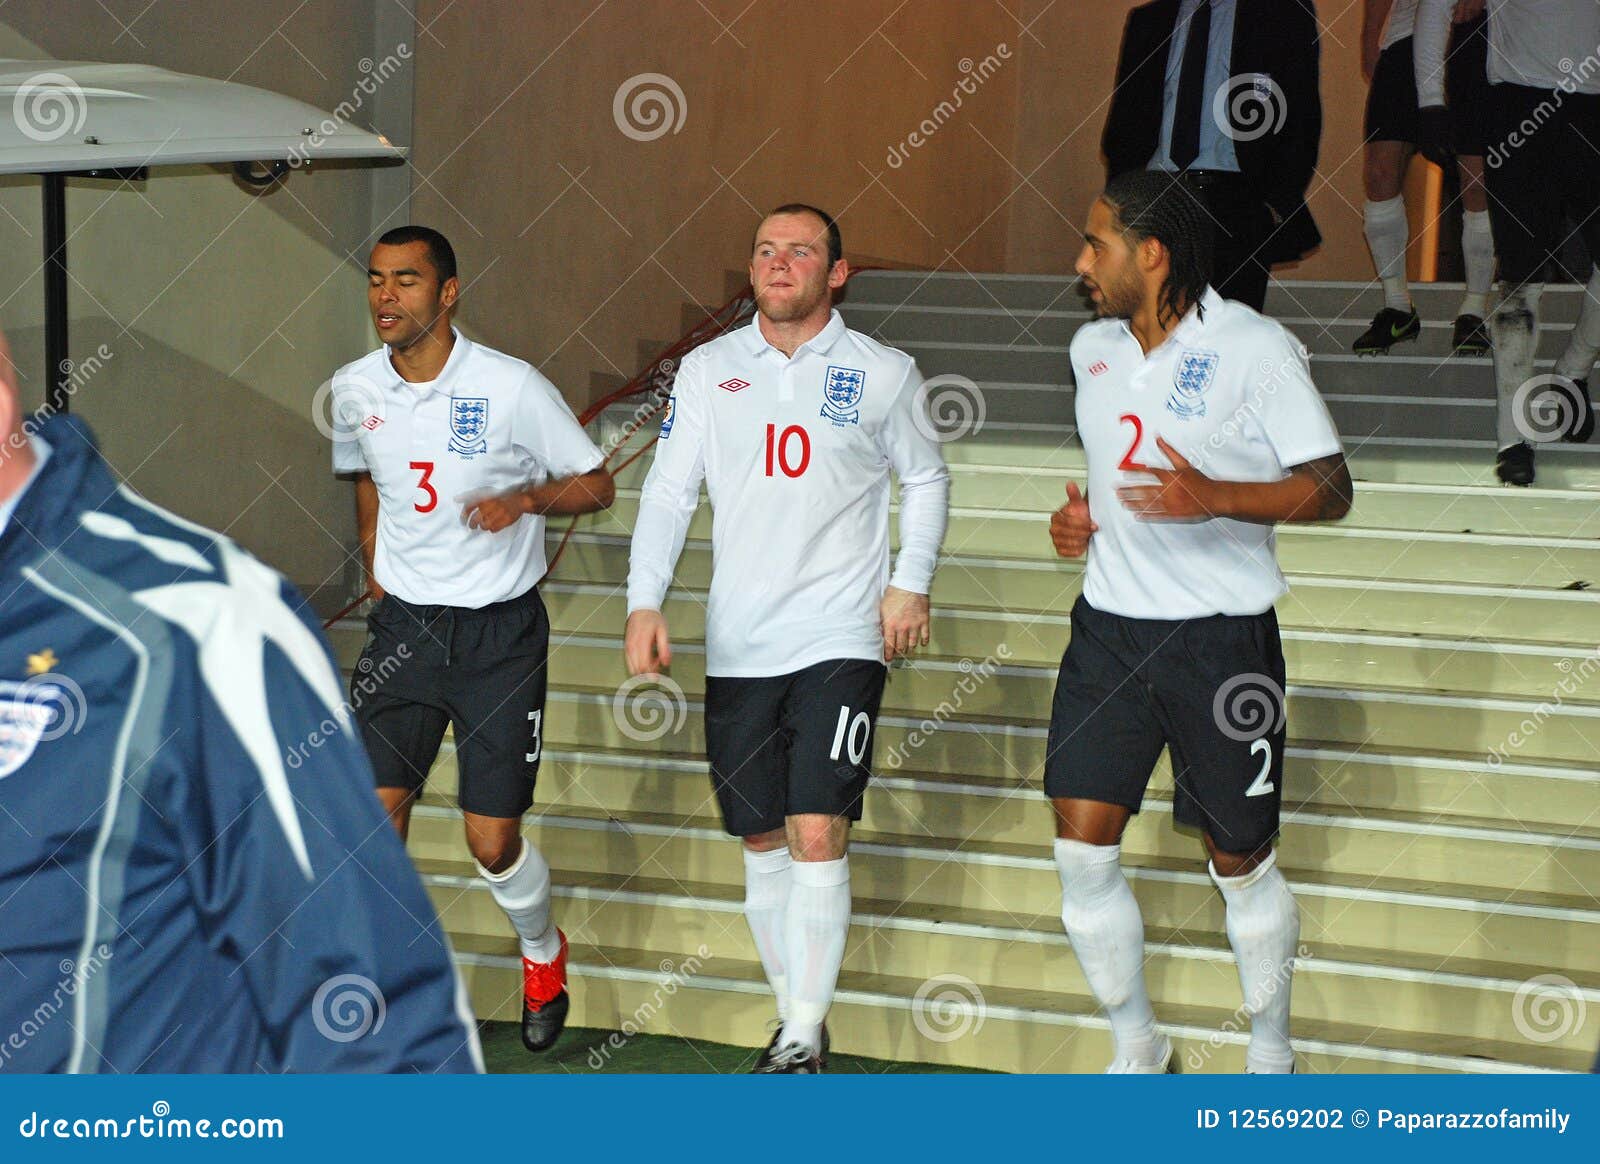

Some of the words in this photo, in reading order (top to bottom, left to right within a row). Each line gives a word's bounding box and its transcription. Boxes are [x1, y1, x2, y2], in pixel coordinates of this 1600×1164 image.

[765, 424, 811, 478] 10
[1118, 413, 1147, 471] 2
[409, 461, 438, 513] 3
[525, 709, 541, 762] 3
[830, 705, 871, 766] 10
[1245, 738, 1274, 796] 2
